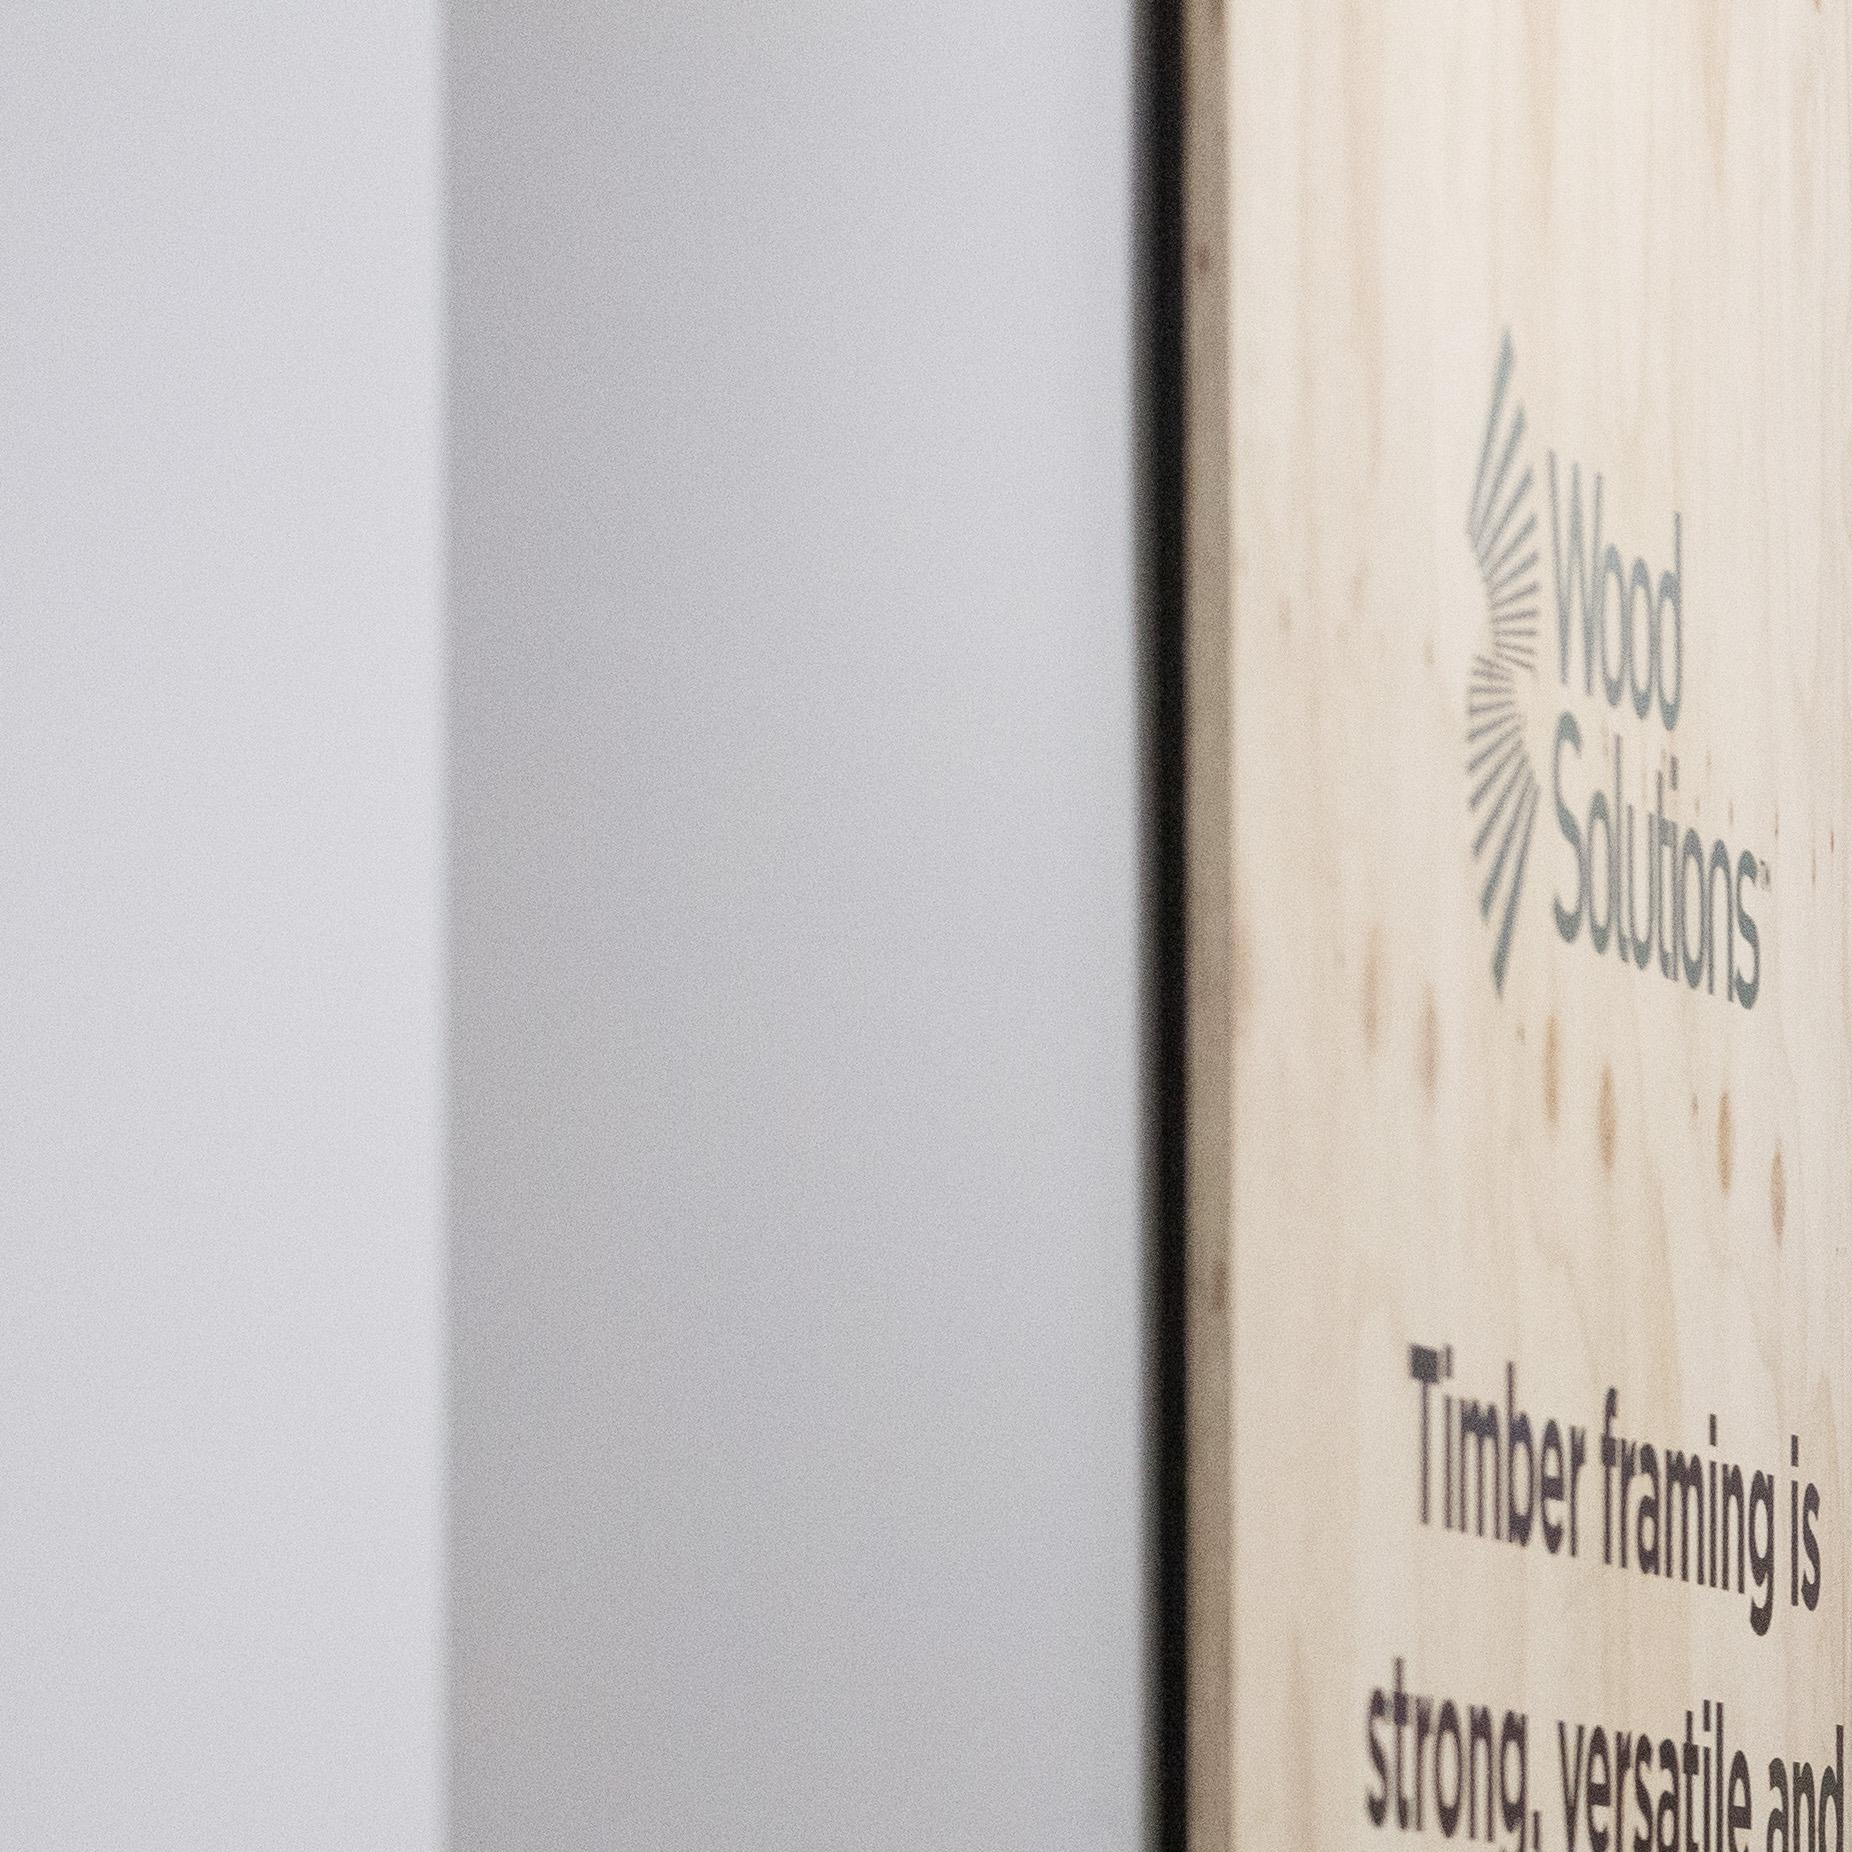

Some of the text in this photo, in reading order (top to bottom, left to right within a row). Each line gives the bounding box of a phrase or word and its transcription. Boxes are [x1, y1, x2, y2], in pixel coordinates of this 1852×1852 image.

[1548, 448, 1684, 731] Wood
[1408, 1343, 1822, 1637] Timber framing is
